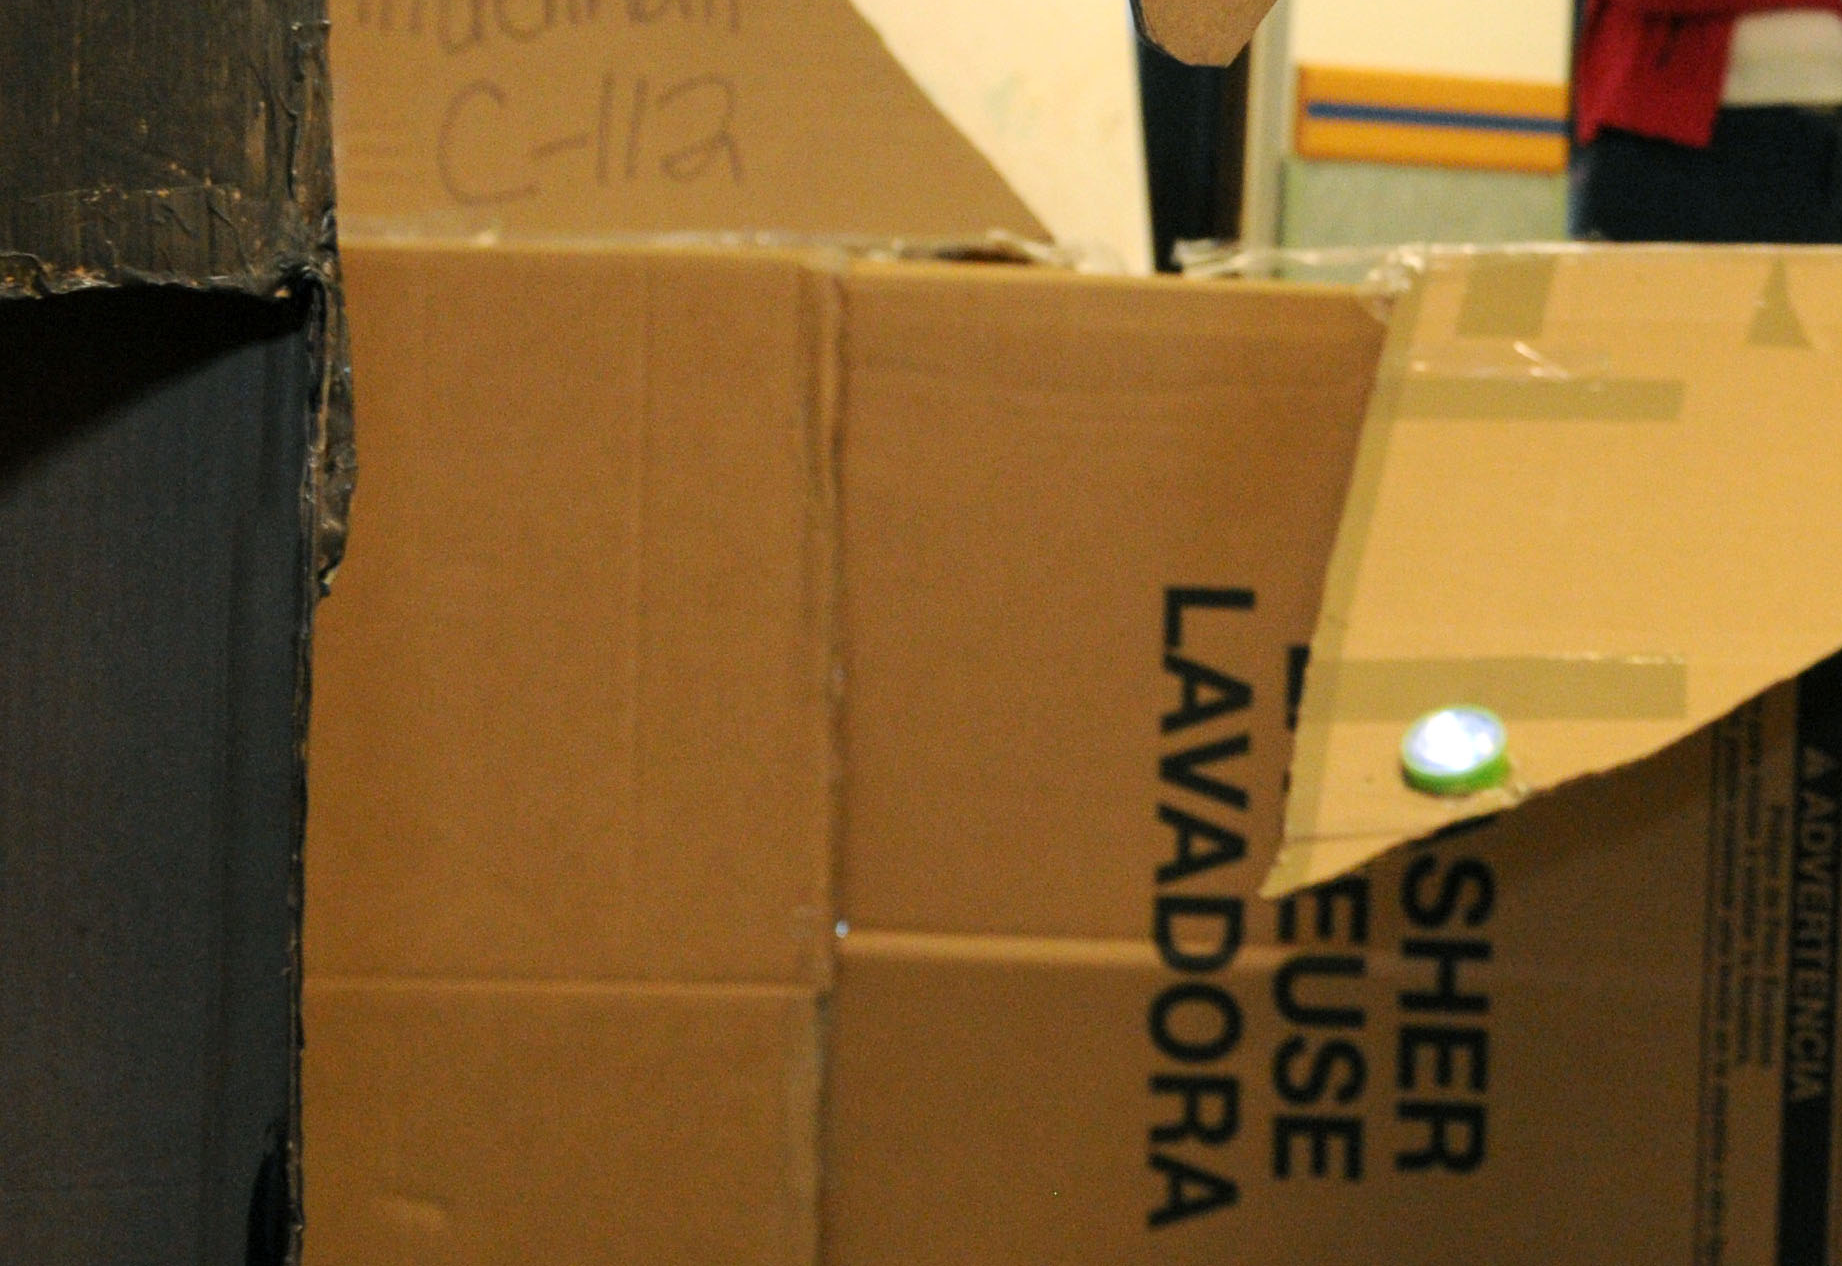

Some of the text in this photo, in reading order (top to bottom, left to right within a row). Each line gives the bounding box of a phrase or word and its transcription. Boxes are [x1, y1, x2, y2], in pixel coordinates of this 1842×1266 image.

[1147, 586, 1256, 1229] LAVADORA
[1391, 819, 1496, 1177] SHER
[1789, 788, 1836, 1103] ADVERTENCIA
